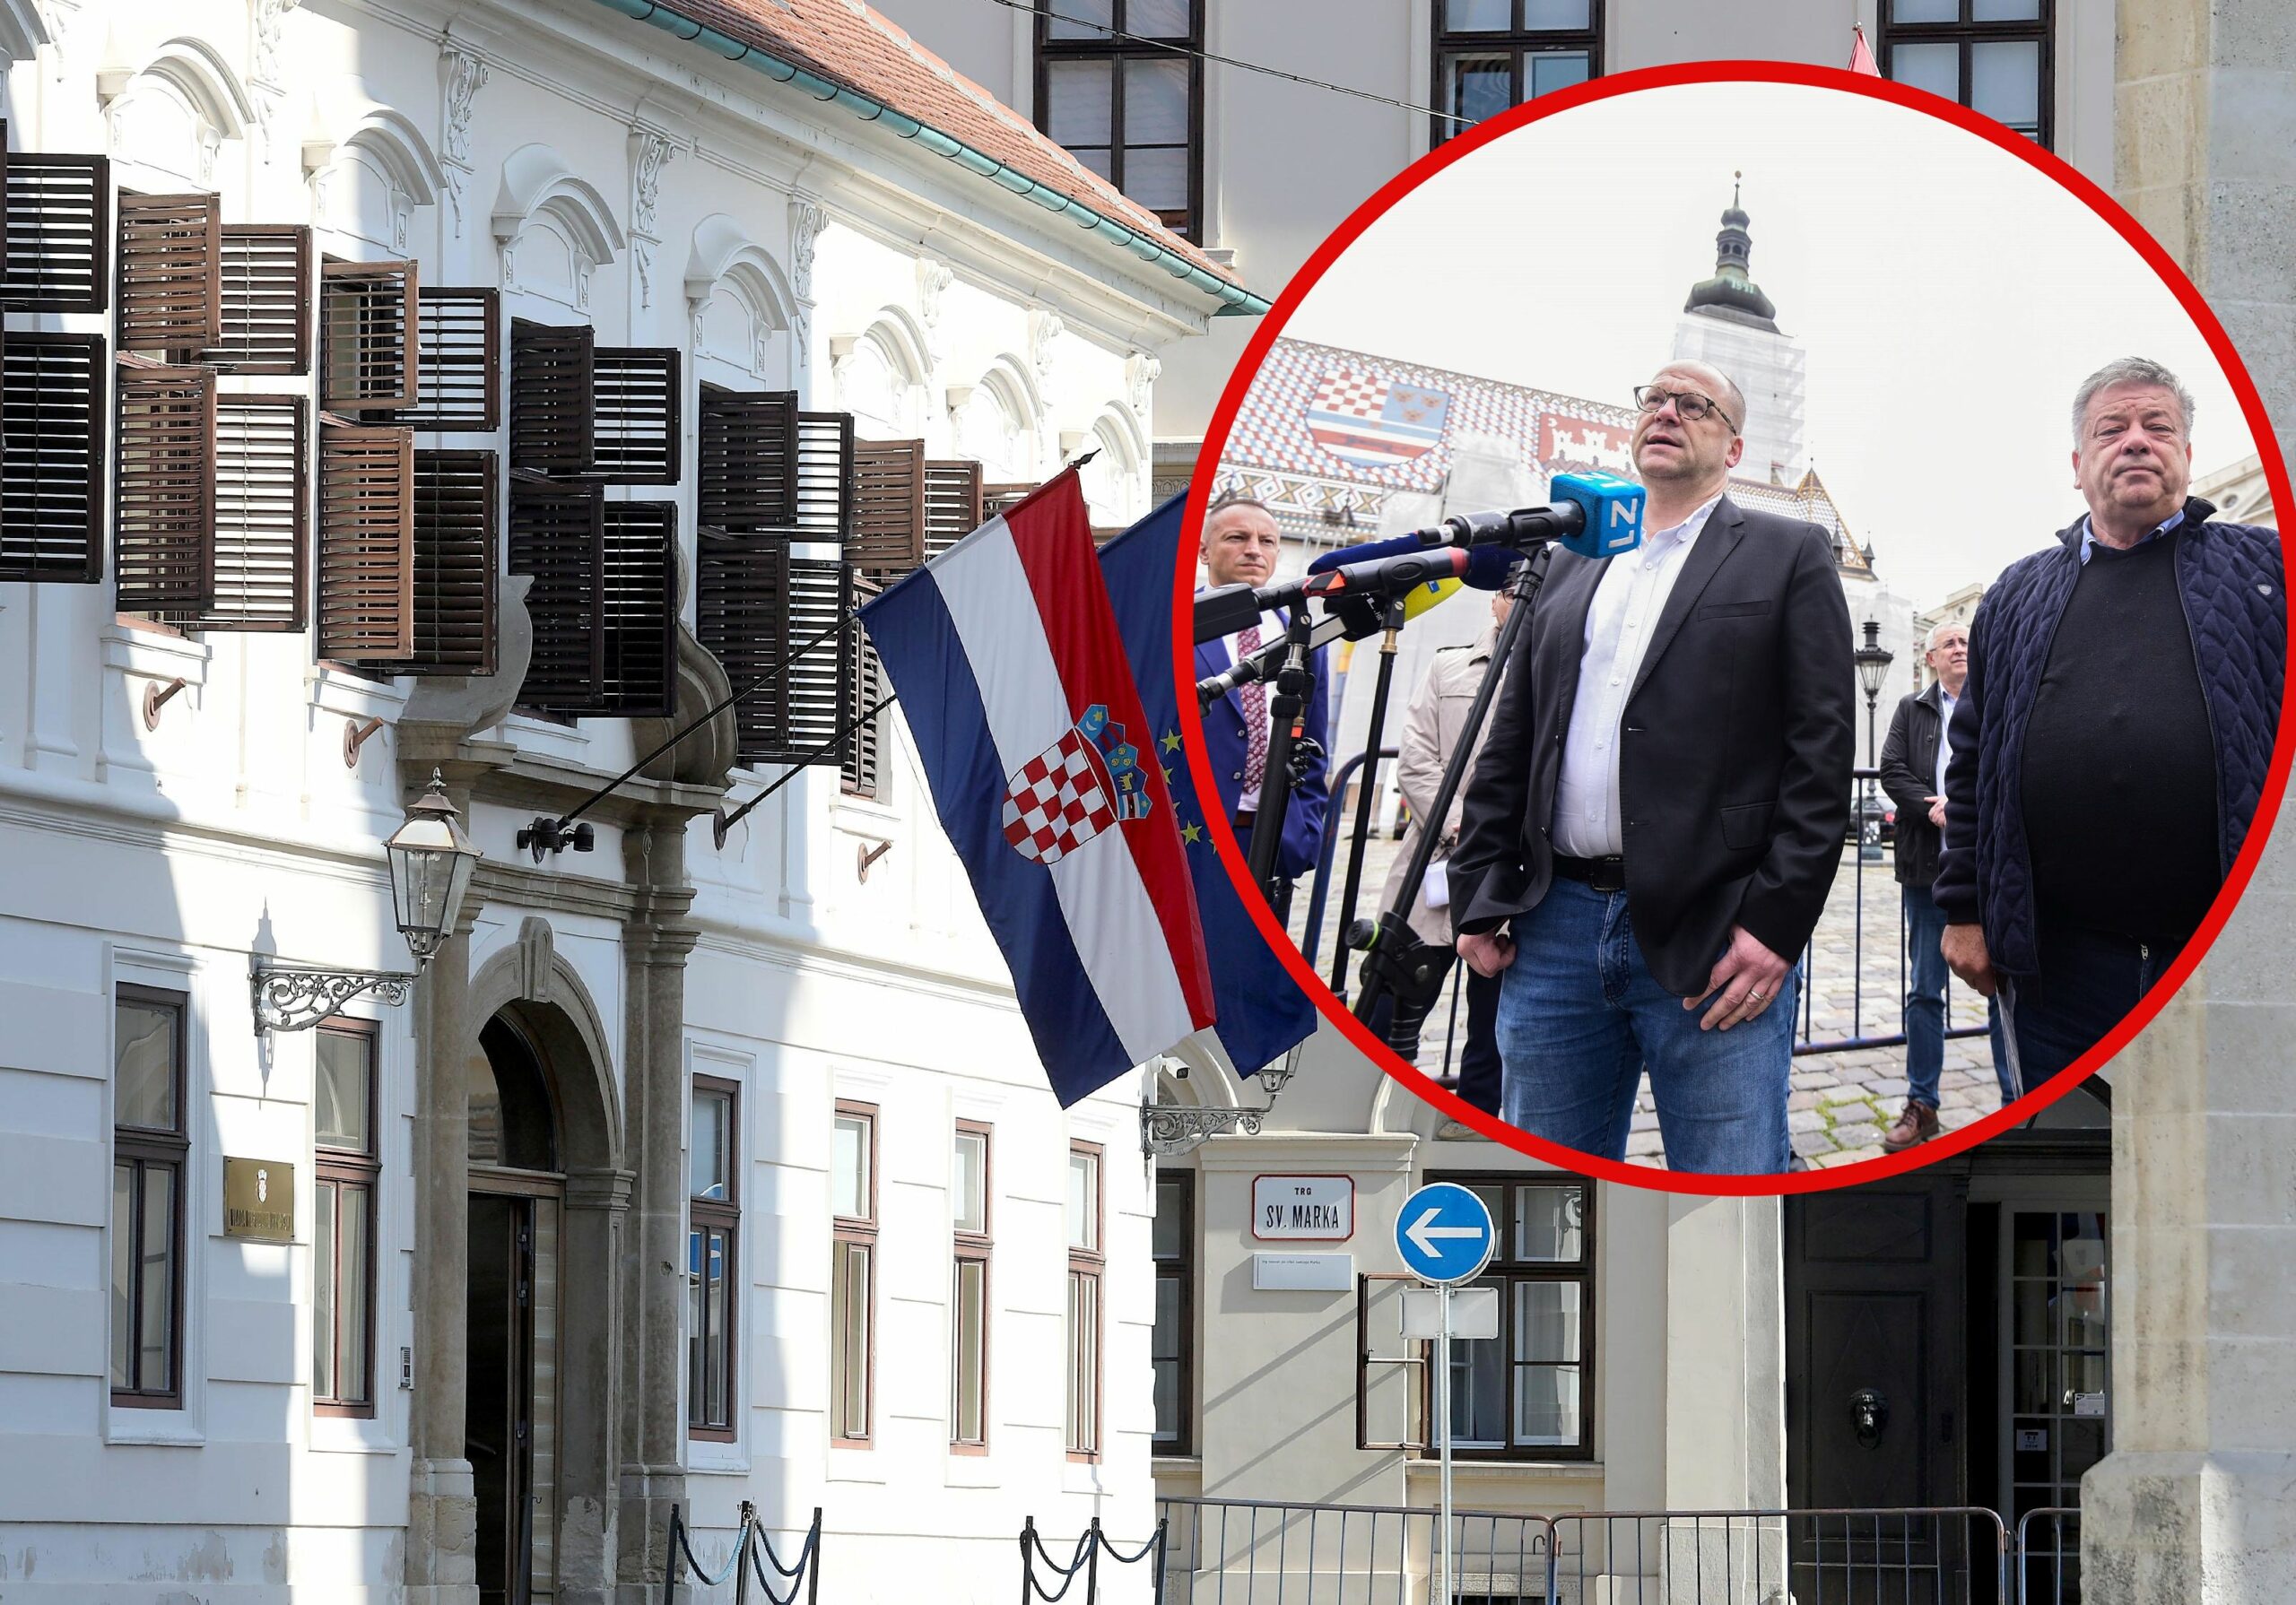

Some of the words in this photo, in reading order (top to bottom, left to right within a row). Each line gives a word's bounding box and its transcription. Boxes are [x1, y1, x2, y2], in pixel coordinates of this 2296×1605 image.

[1608, 498, 1638, 549] N1
[1294, 1187, 1312, 1195] TRG
[1266, 1205, 1287, 1228] SV.
[1292, 1205, 1339, 1228] MARKA
